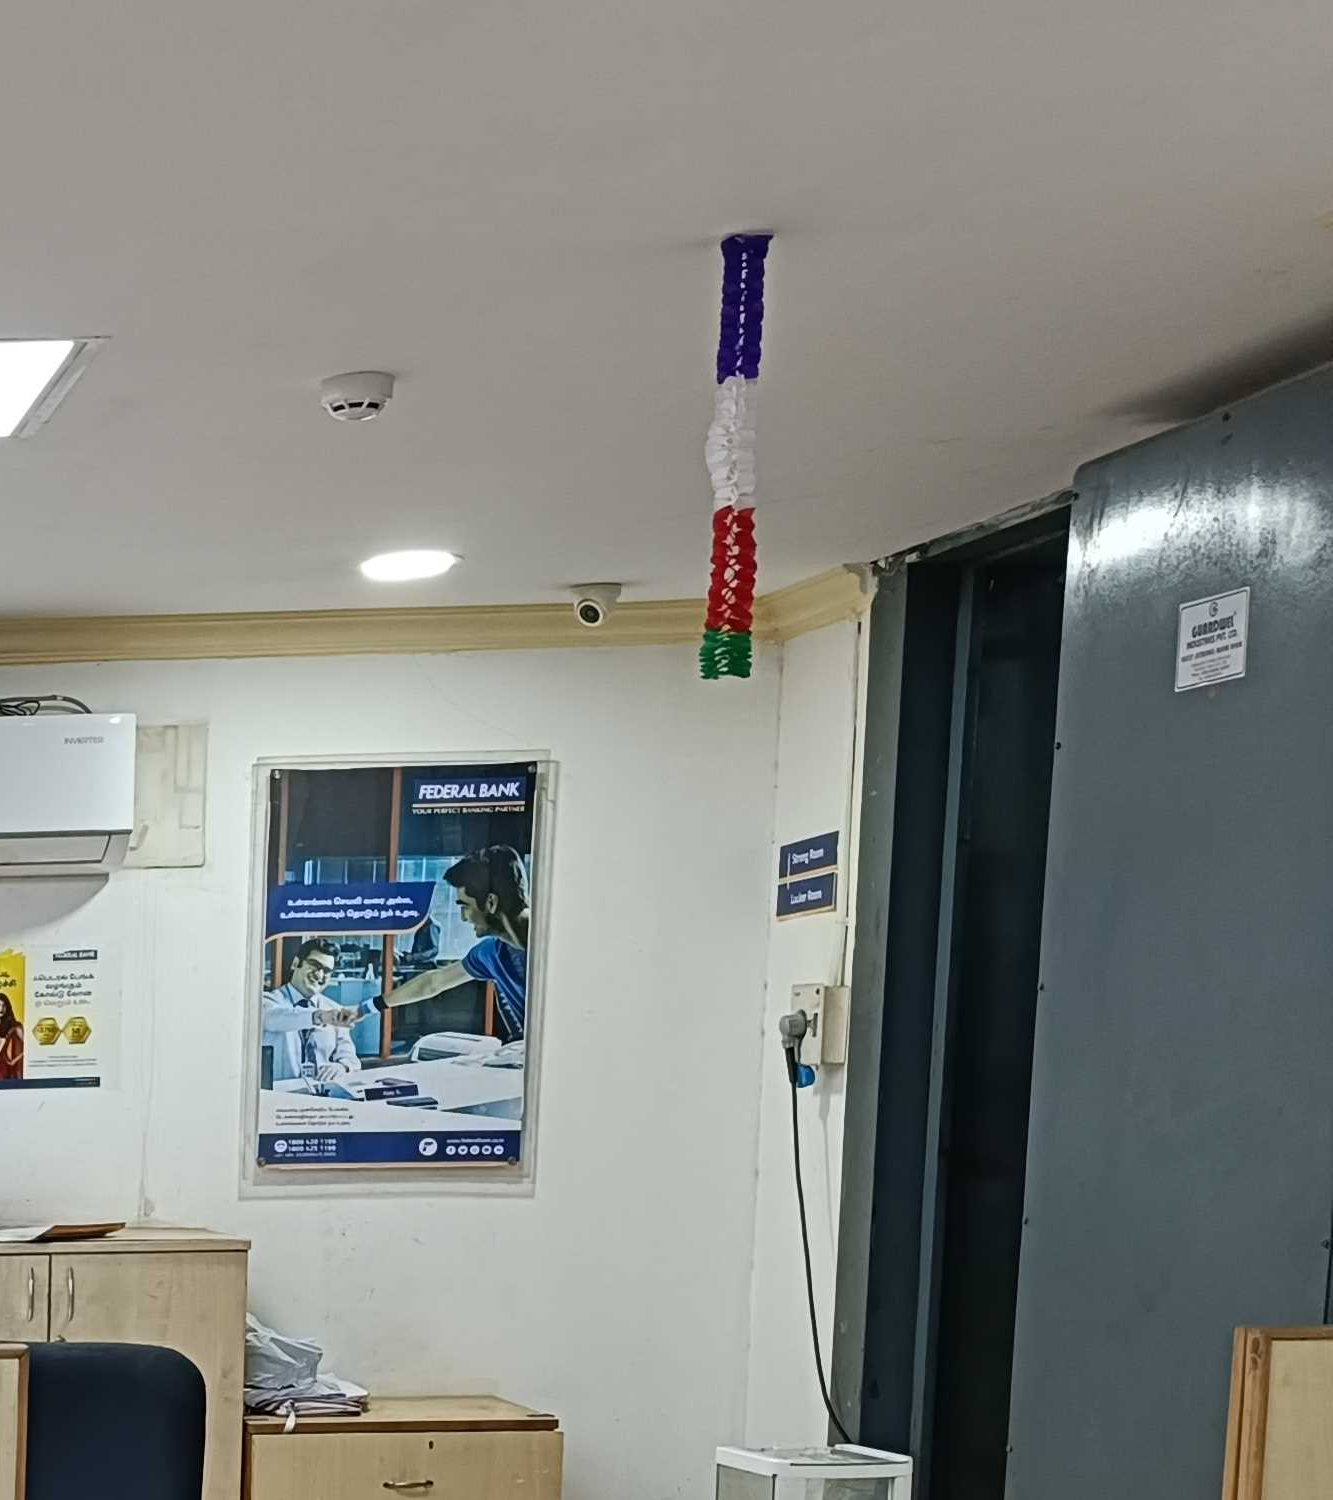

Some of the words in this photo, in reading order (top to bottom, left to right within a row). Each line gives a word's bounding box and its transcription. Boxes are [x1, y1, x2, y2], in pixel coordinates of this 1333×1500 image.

[418, 784, 477, 800] FEDERAL
[479, 781, 521, 798] BANK
[792, 852, 808, 864] Strong
[810, 848, 824, 860] Room
[808, 889, 822, 901] Room
